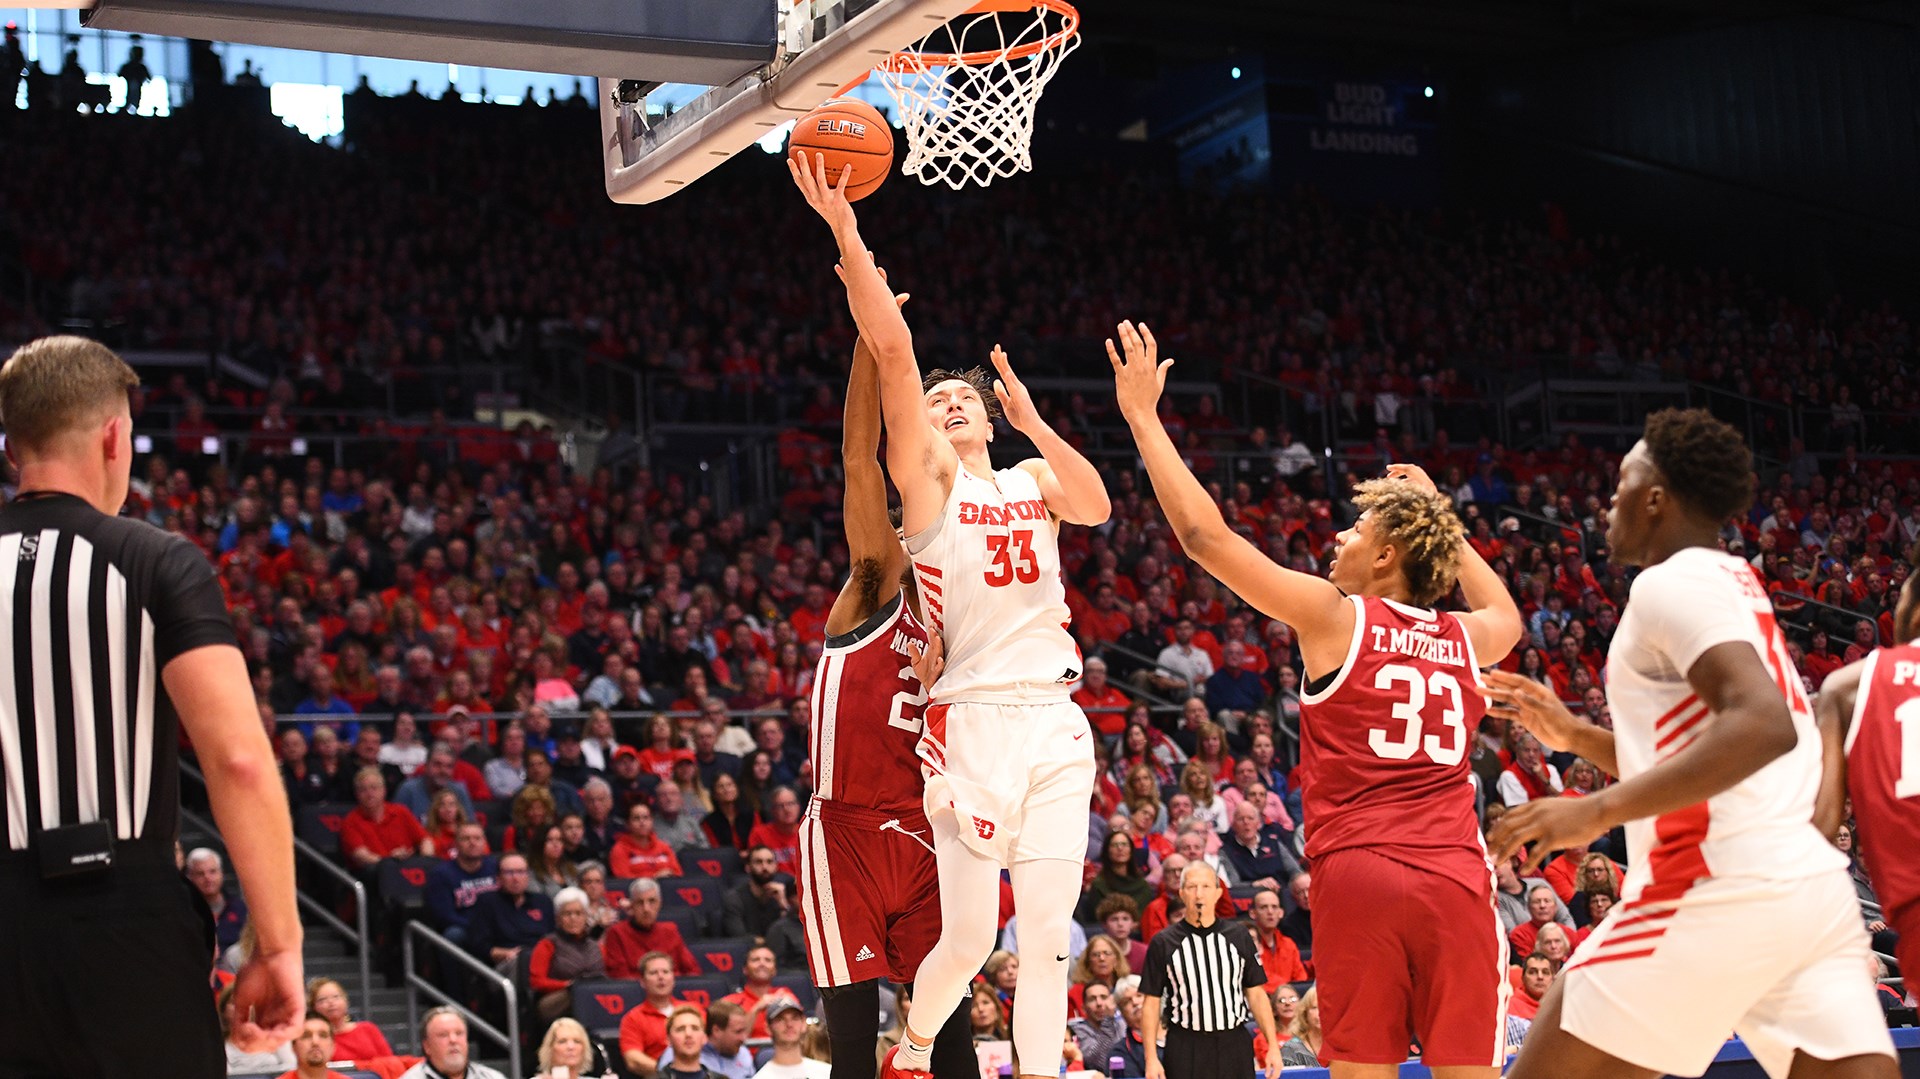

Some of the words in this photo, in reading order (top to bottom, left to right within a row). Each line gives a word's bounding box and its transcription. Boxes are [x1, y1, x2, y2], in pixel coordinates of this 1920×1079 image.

[1335, 82, 1386, 104] BUD
[1327, 102, 1396, 125] LIGHT
[817, 119, 865, 137] ELITE
[1310, 130, 1418, 156] LANDING
[958, 500, 1047, 526] DAYTON
[984, 530, 1040, 587] 33
[1368, 664, 1467, 766] 33
